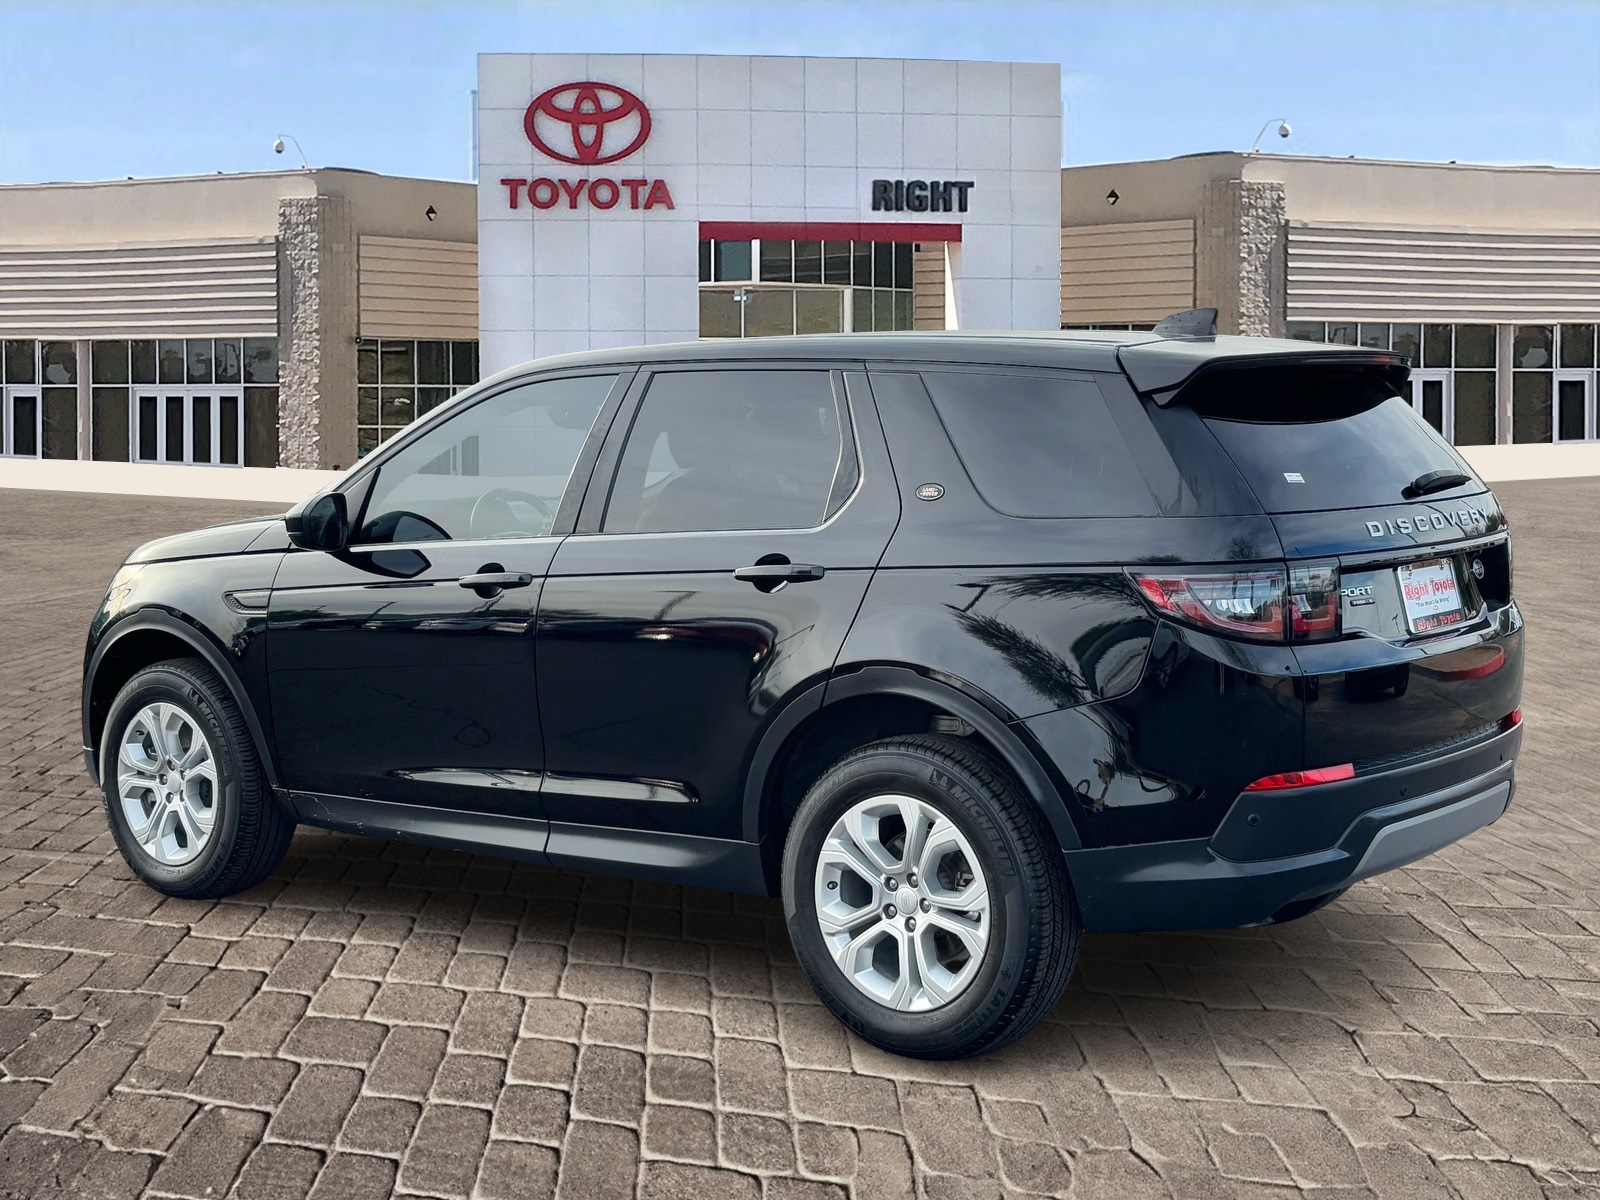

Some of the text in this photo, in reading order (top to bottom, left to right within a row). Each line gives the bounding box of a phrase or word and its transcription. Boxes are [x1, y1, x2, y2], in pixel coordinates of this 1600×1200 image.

[500, 178, 675, 210] TOYOTA
[871, 179, 975, 213] RIGHT
[1365, 508, 1488, 537] DISCOVERY
[1340, 585, 1373, 597] PORT
[1404, 583, 1429, 601] Right
